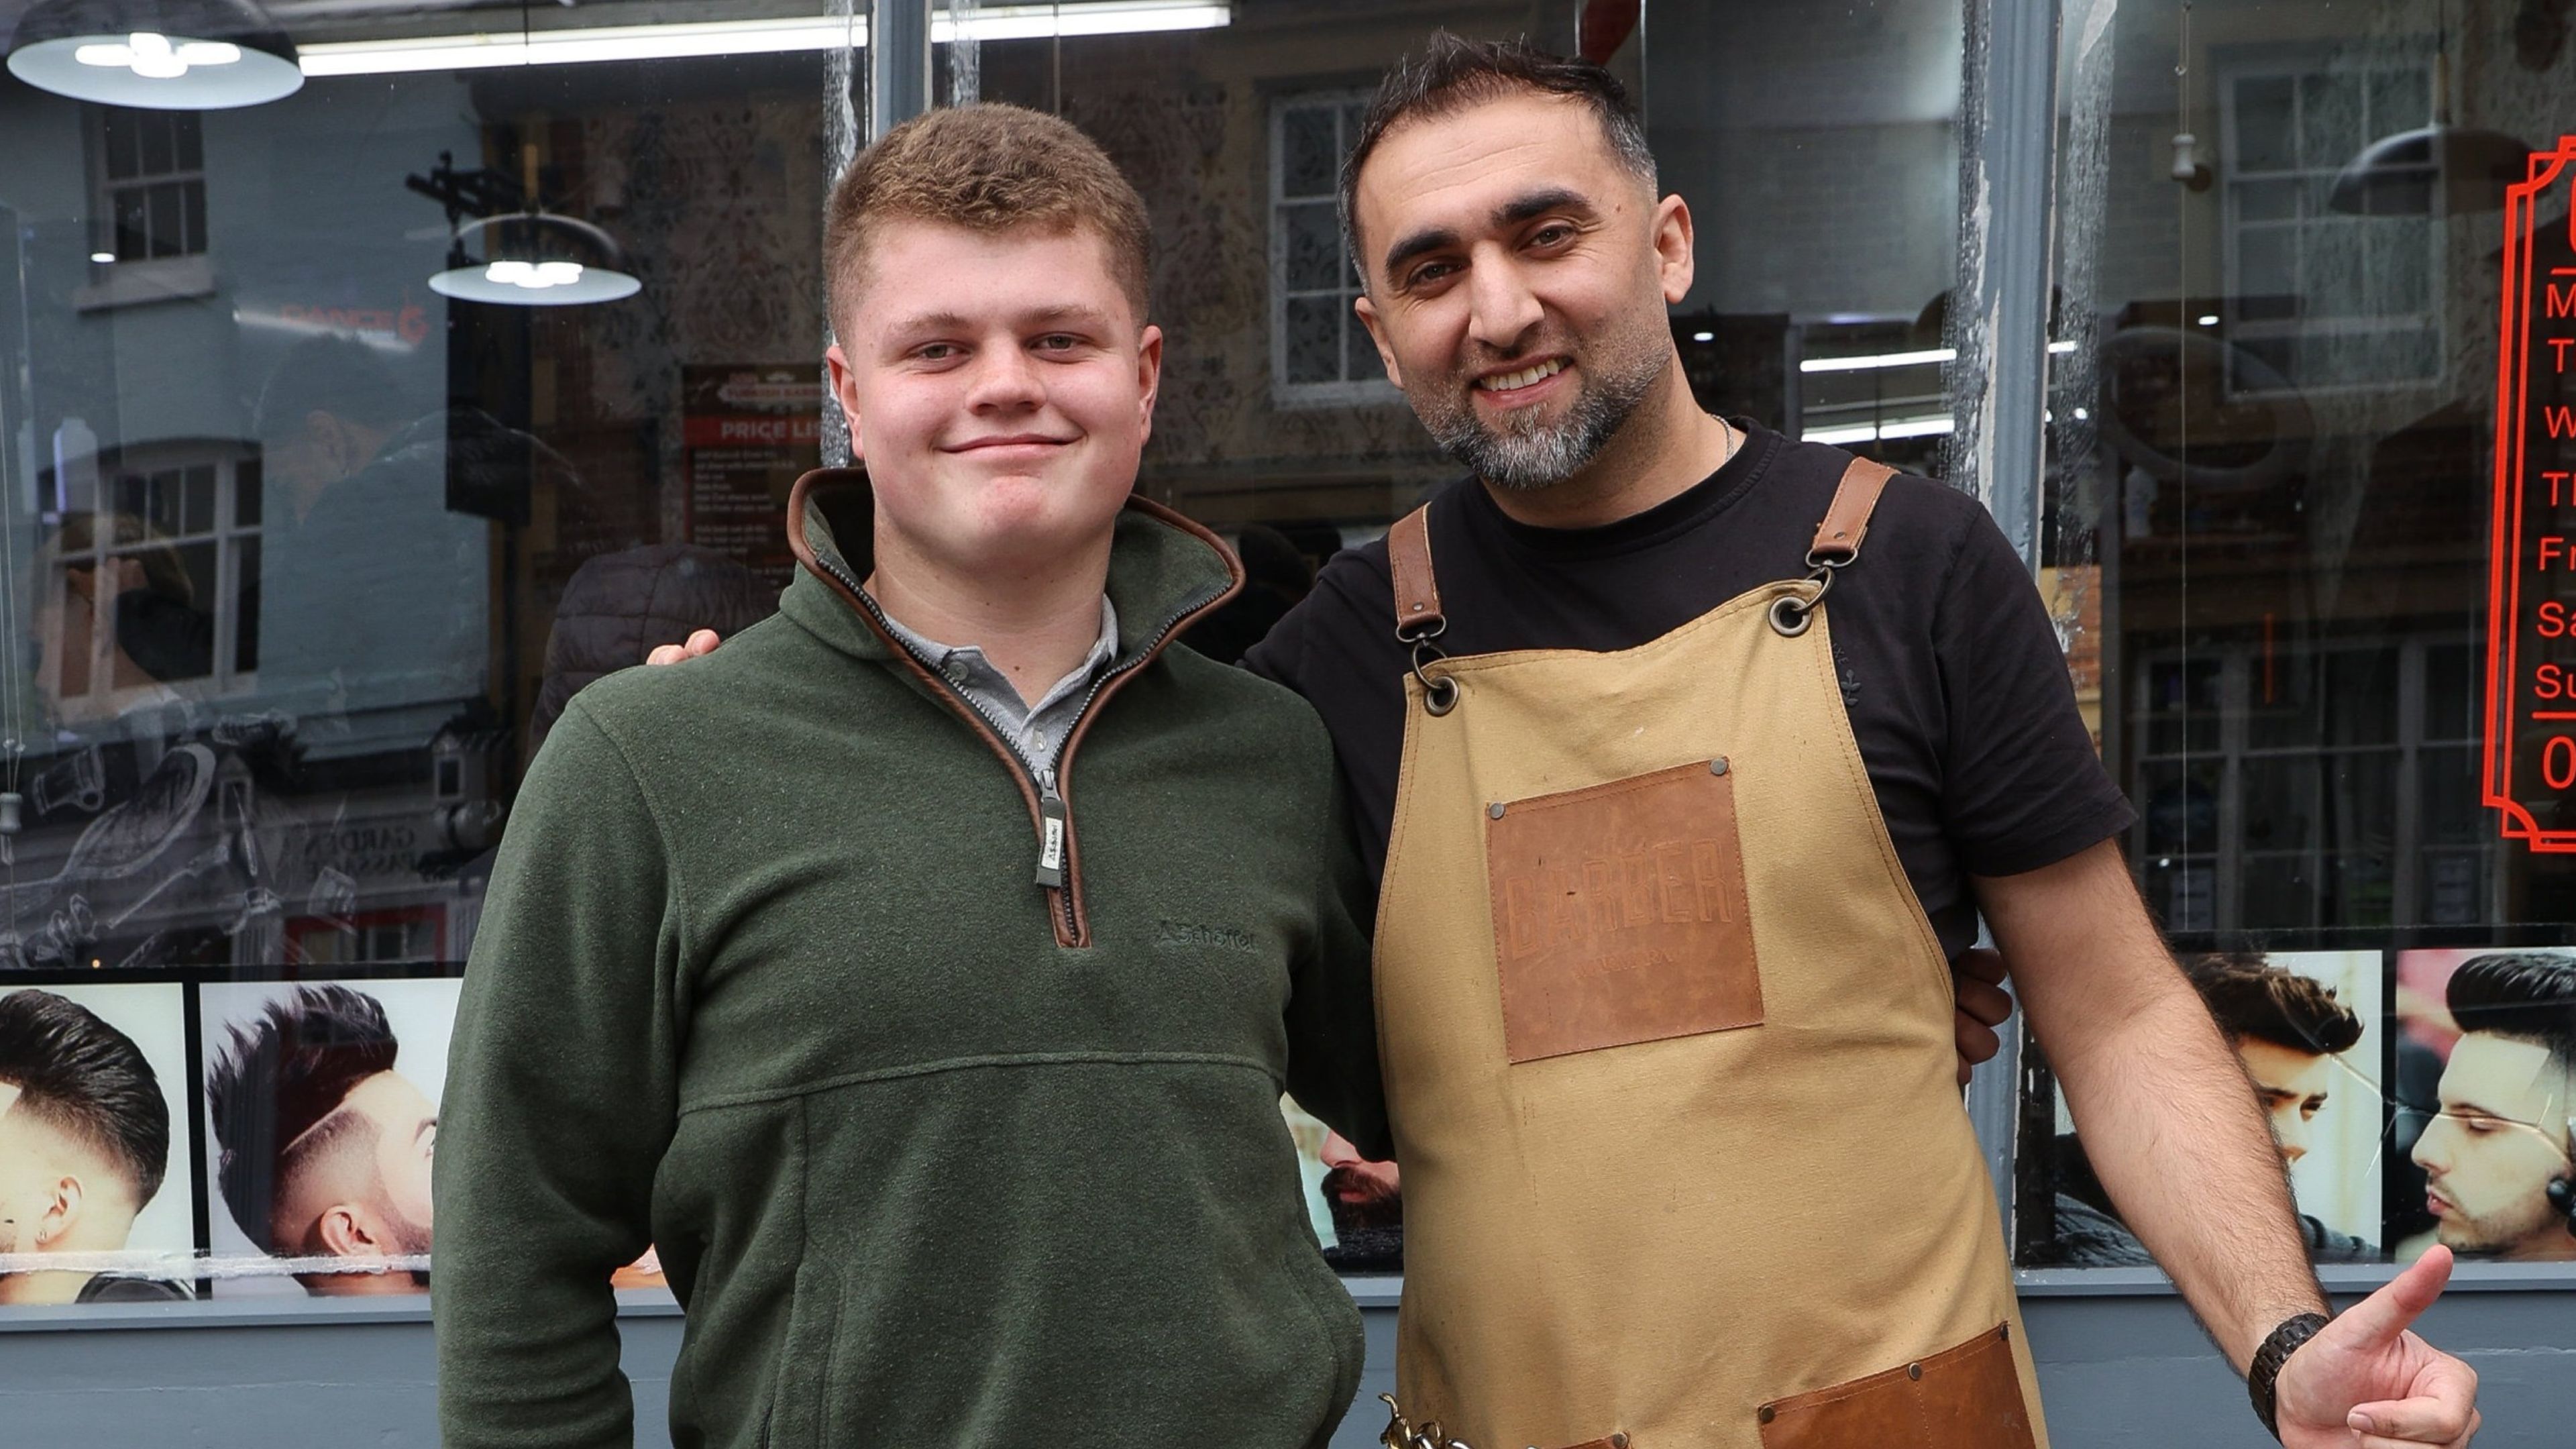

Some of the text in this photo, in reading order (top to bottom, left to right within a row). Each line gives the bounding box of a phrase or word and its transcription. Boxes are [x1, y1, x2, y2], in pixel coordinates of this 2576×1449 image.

[721, 420, 788, 439] PRICE
[2542, 472, 2576, 505] T
[1505, 837, 1733, 961] BARBER
